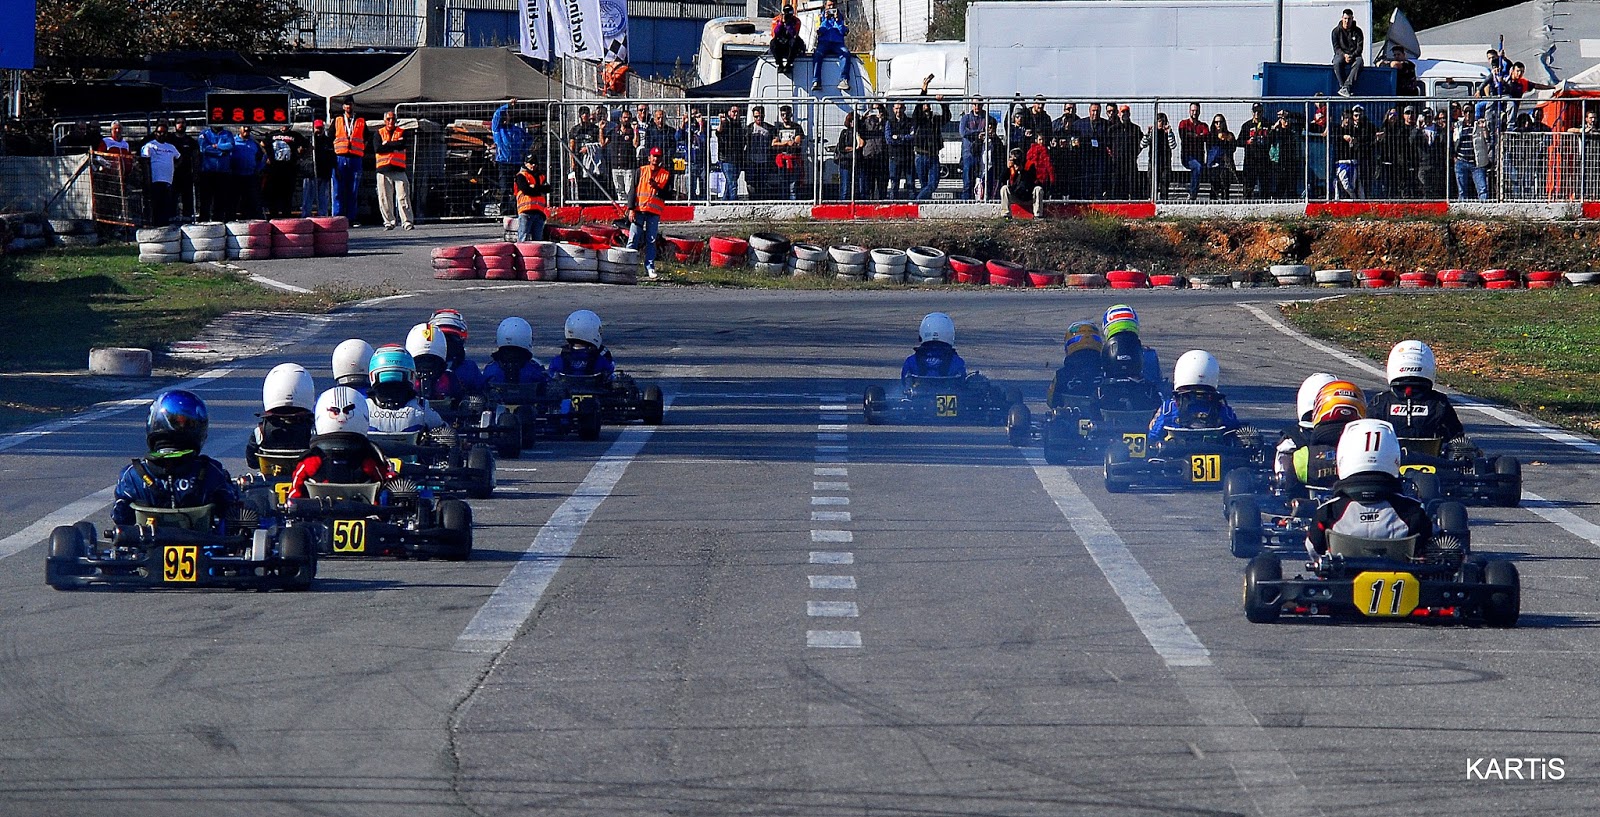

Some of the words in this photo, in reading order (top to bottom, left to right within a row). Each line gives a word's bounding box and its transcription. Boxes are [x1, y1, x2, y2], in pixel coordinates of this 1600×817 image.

[369, 407, 410, 419] LOSONCZY
[937, 396, 956, 415] 34
[1122, 436, 1144, 454] 29
[1365, 431, 1381, 452] 11
[1193, 457, 1216, 480] 31
[1360, 513, 1379, 521] OMP
[334, 521, 363, 550] 50
[165, 547, 195, 580] 95
[1369, 579, 1405, 614] 11
